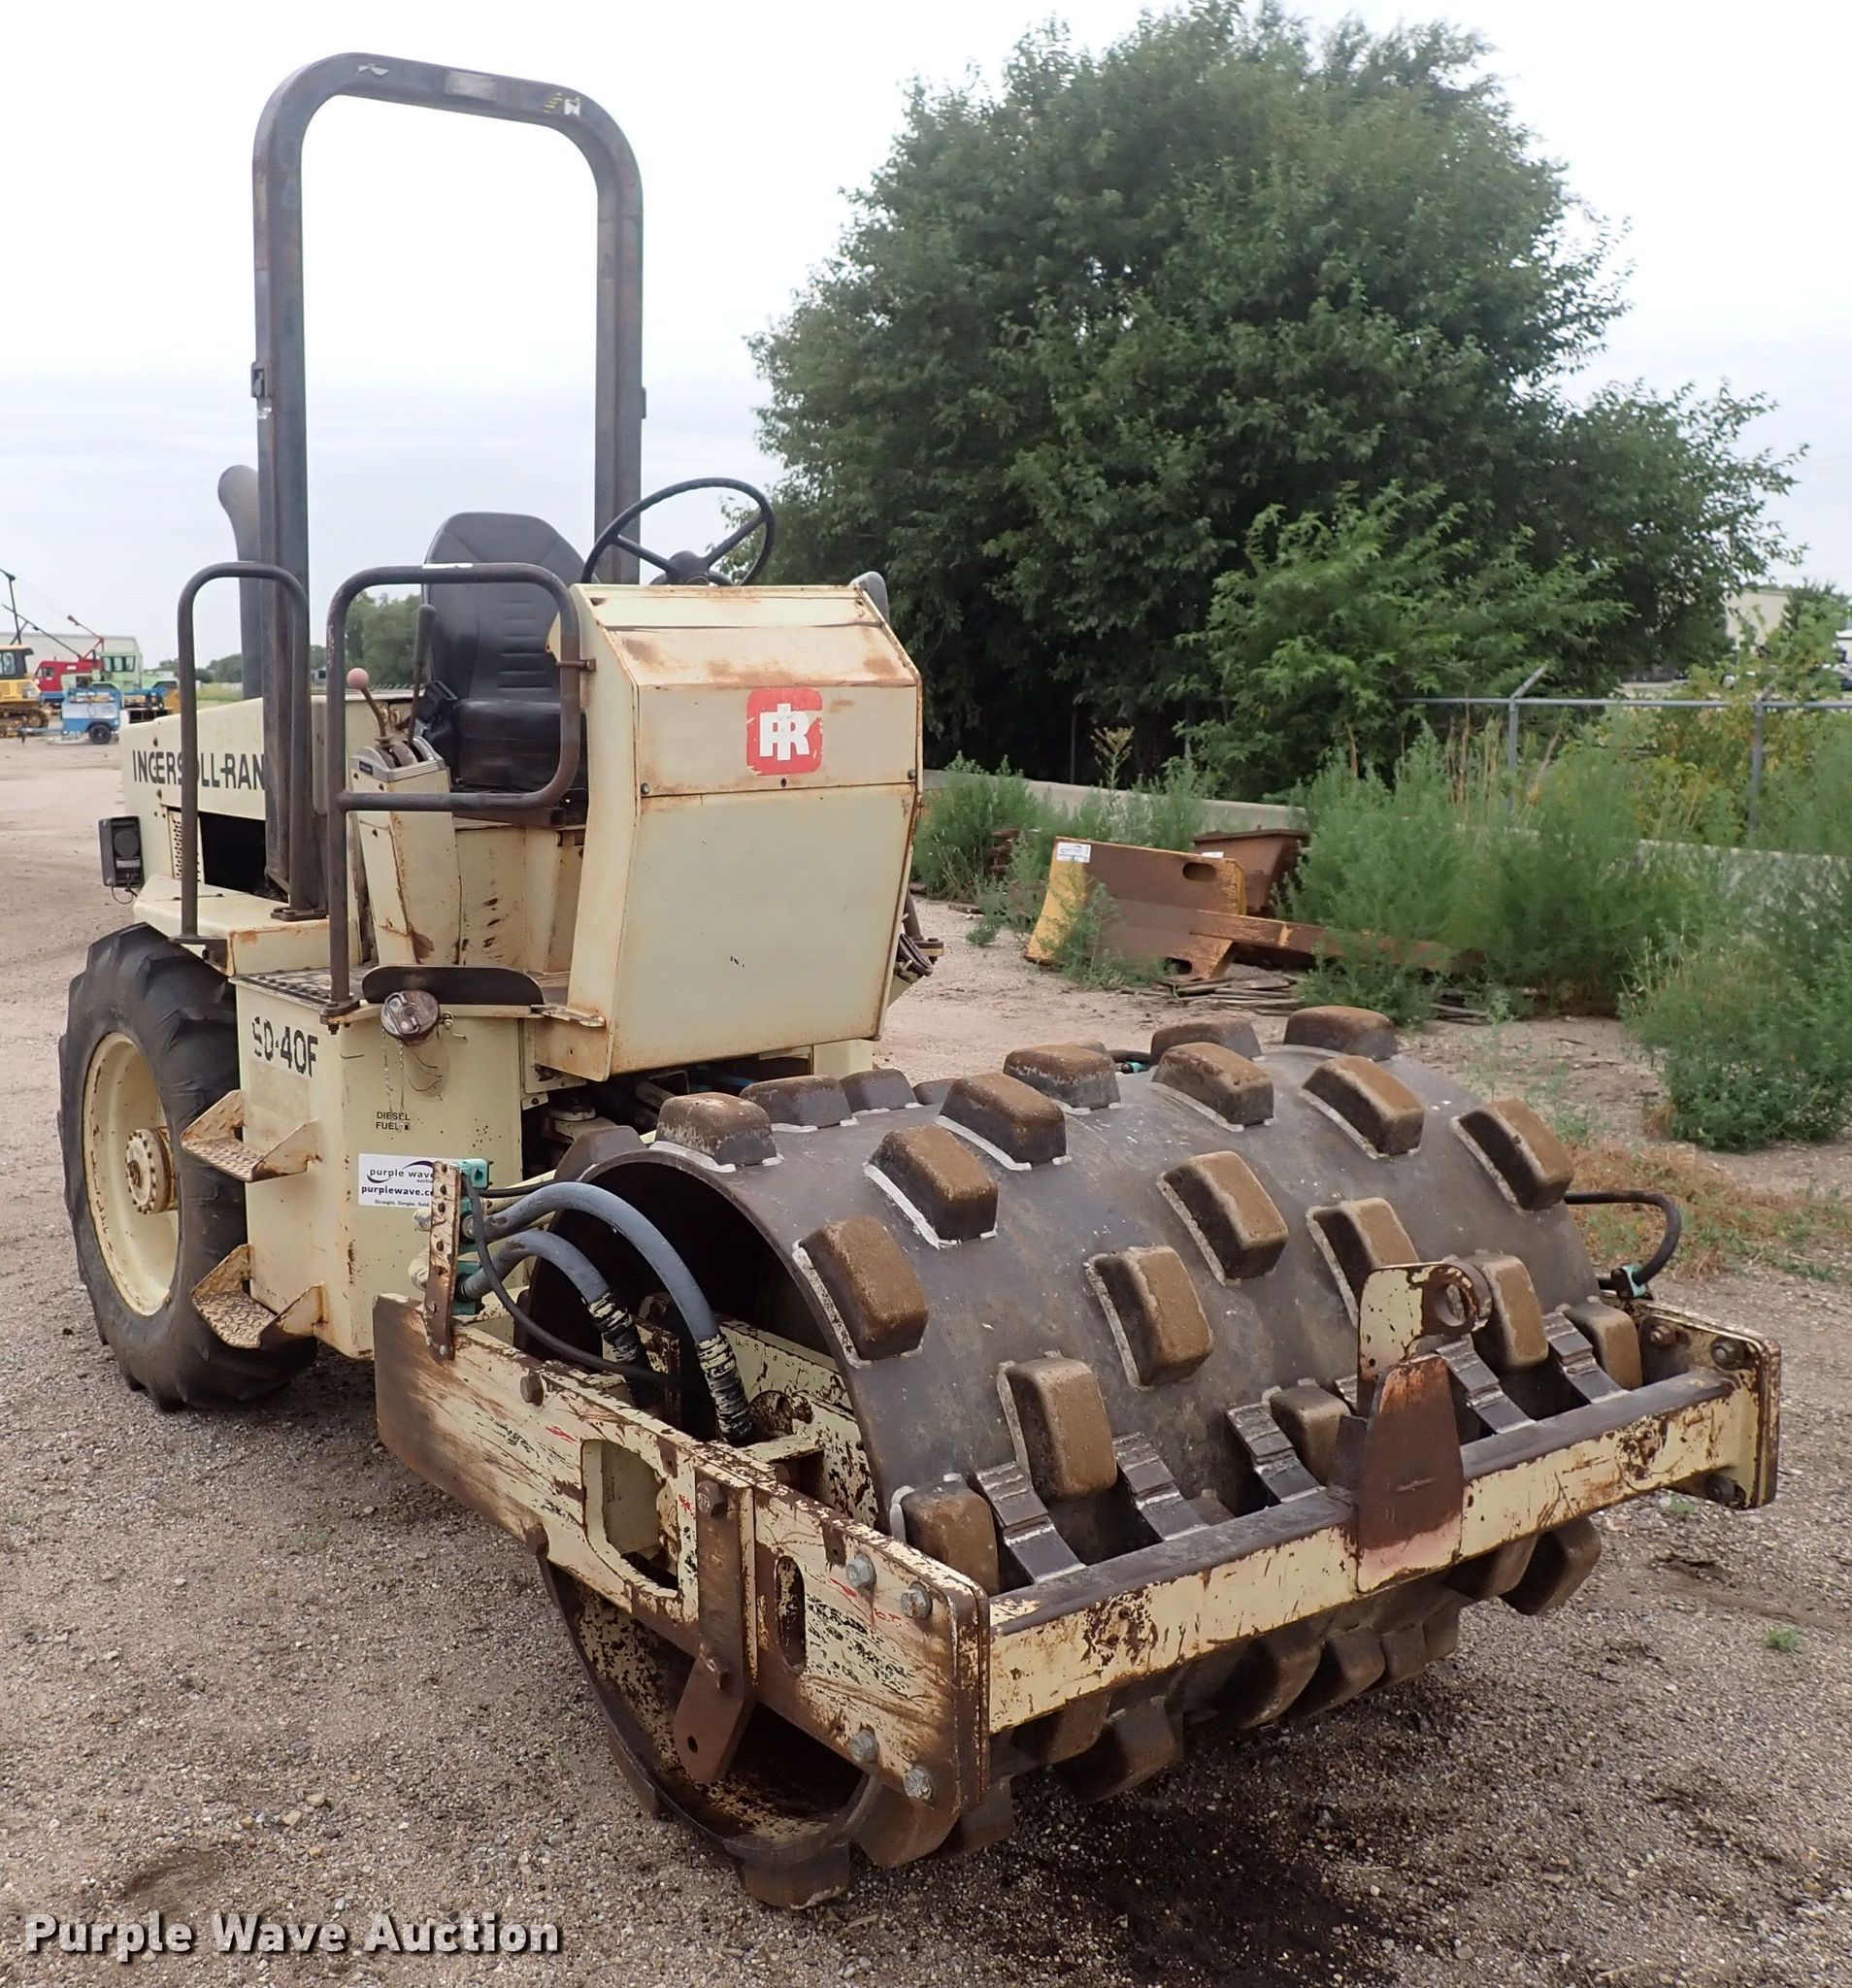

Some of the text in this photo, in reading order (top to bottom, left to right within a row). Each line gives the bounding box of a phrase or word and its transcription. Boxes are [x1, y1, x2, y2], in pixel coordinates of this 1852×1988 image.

[377, 1110, 411, 1121] DIESEL
[376, 1121, 399, 1130] FUEL
[370, 1169, 404, 1177] purple
